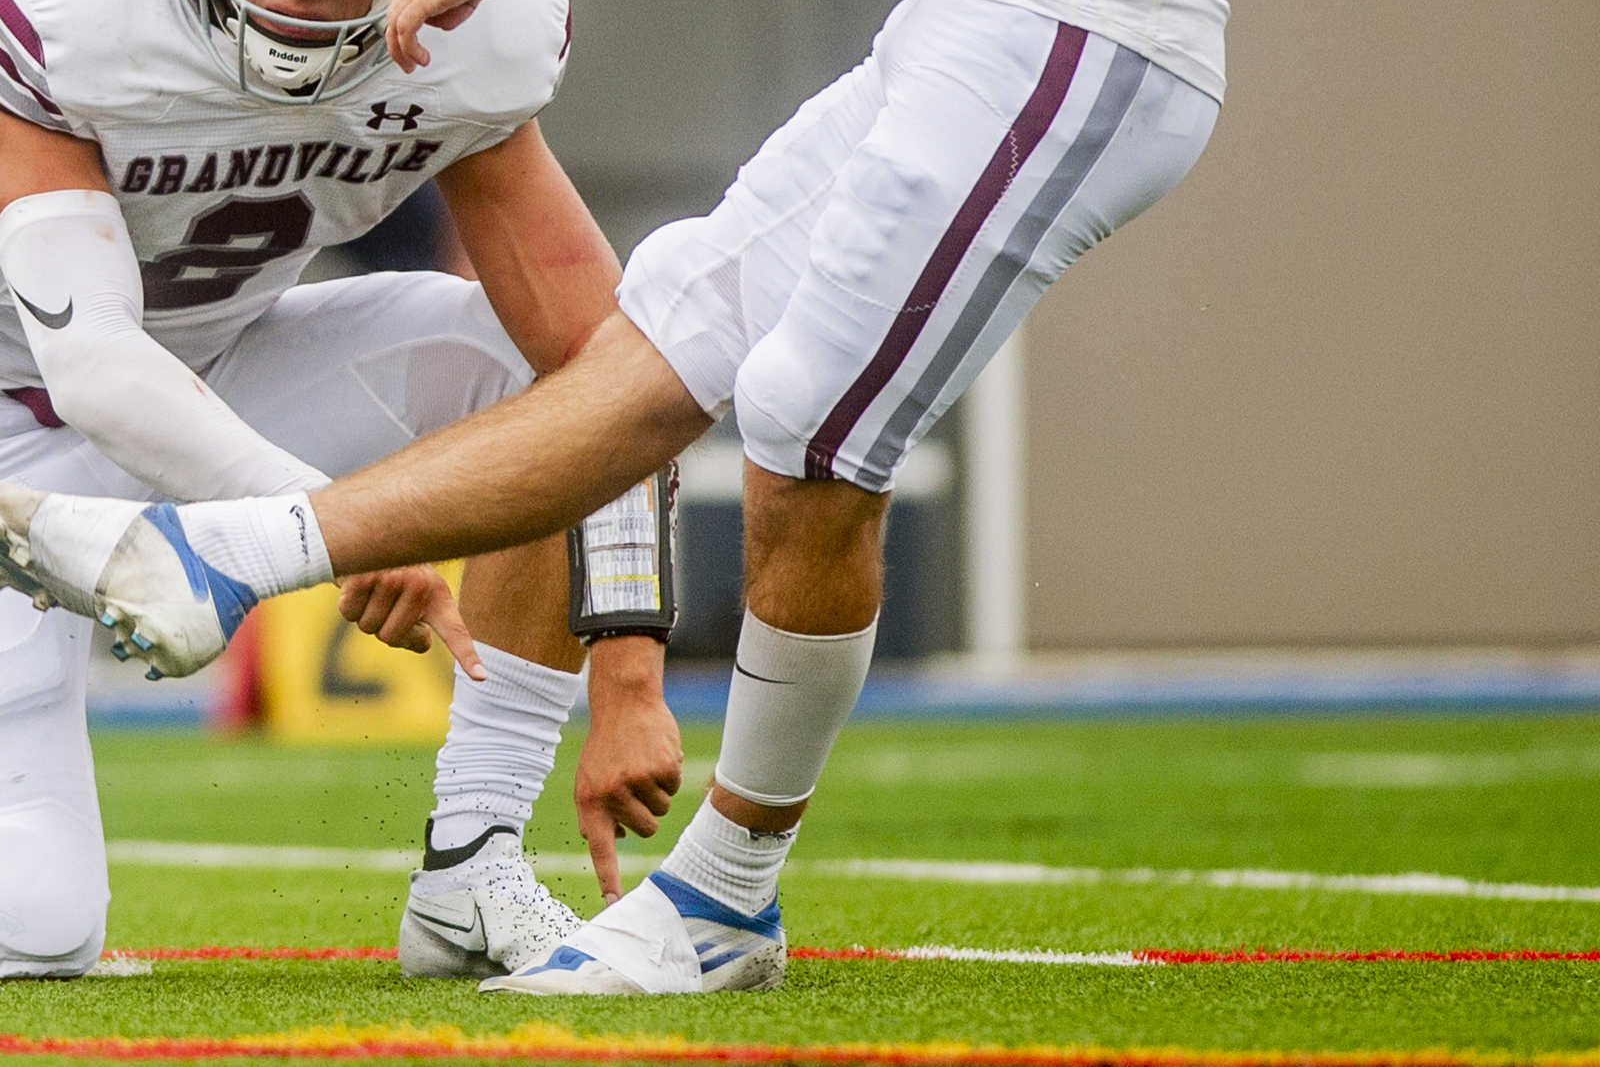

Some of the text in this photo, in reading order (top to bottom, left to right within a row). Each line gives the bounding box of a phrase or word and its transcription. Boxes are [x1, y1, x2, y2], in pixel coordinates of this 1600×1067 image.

[268, 47, 308, 63] Riddell
[120, 139, 444, 195] GRANDVILLE
[140, 189, 316, 311] 2
